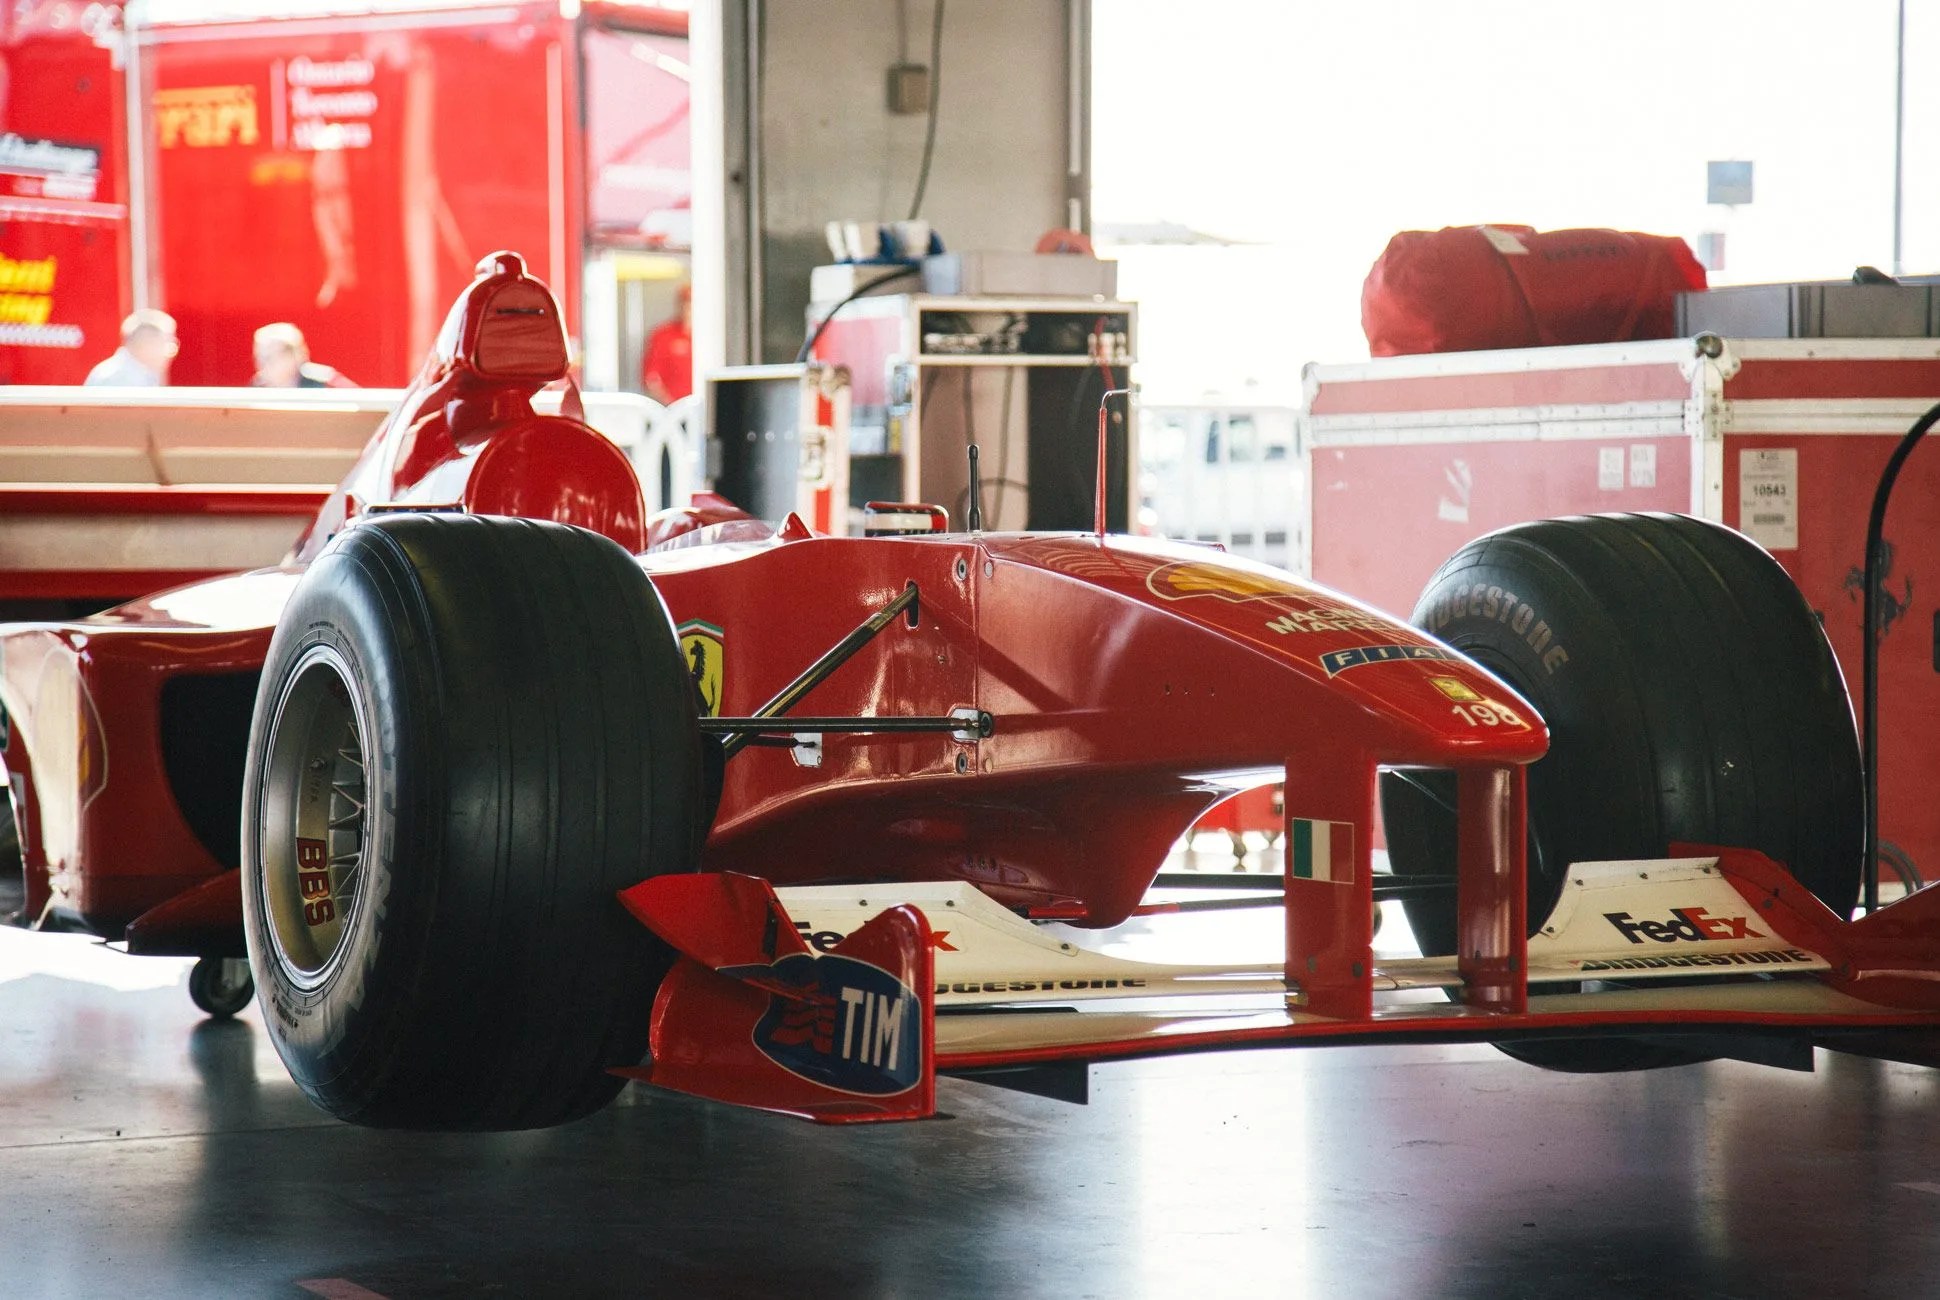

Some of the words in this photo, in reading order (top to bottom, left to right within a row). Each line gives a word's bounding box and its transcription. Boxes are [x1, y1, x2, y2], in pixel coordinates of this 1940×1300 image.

[1335, 647, 1438, 666] FIA
[296, 837, 335, 926] BBS
[1602, 906, 1767, 944] FedEx
[1581, 949, 1812, 971] BRIDGESTONE
[841, 986, 903, 1071] TIM
